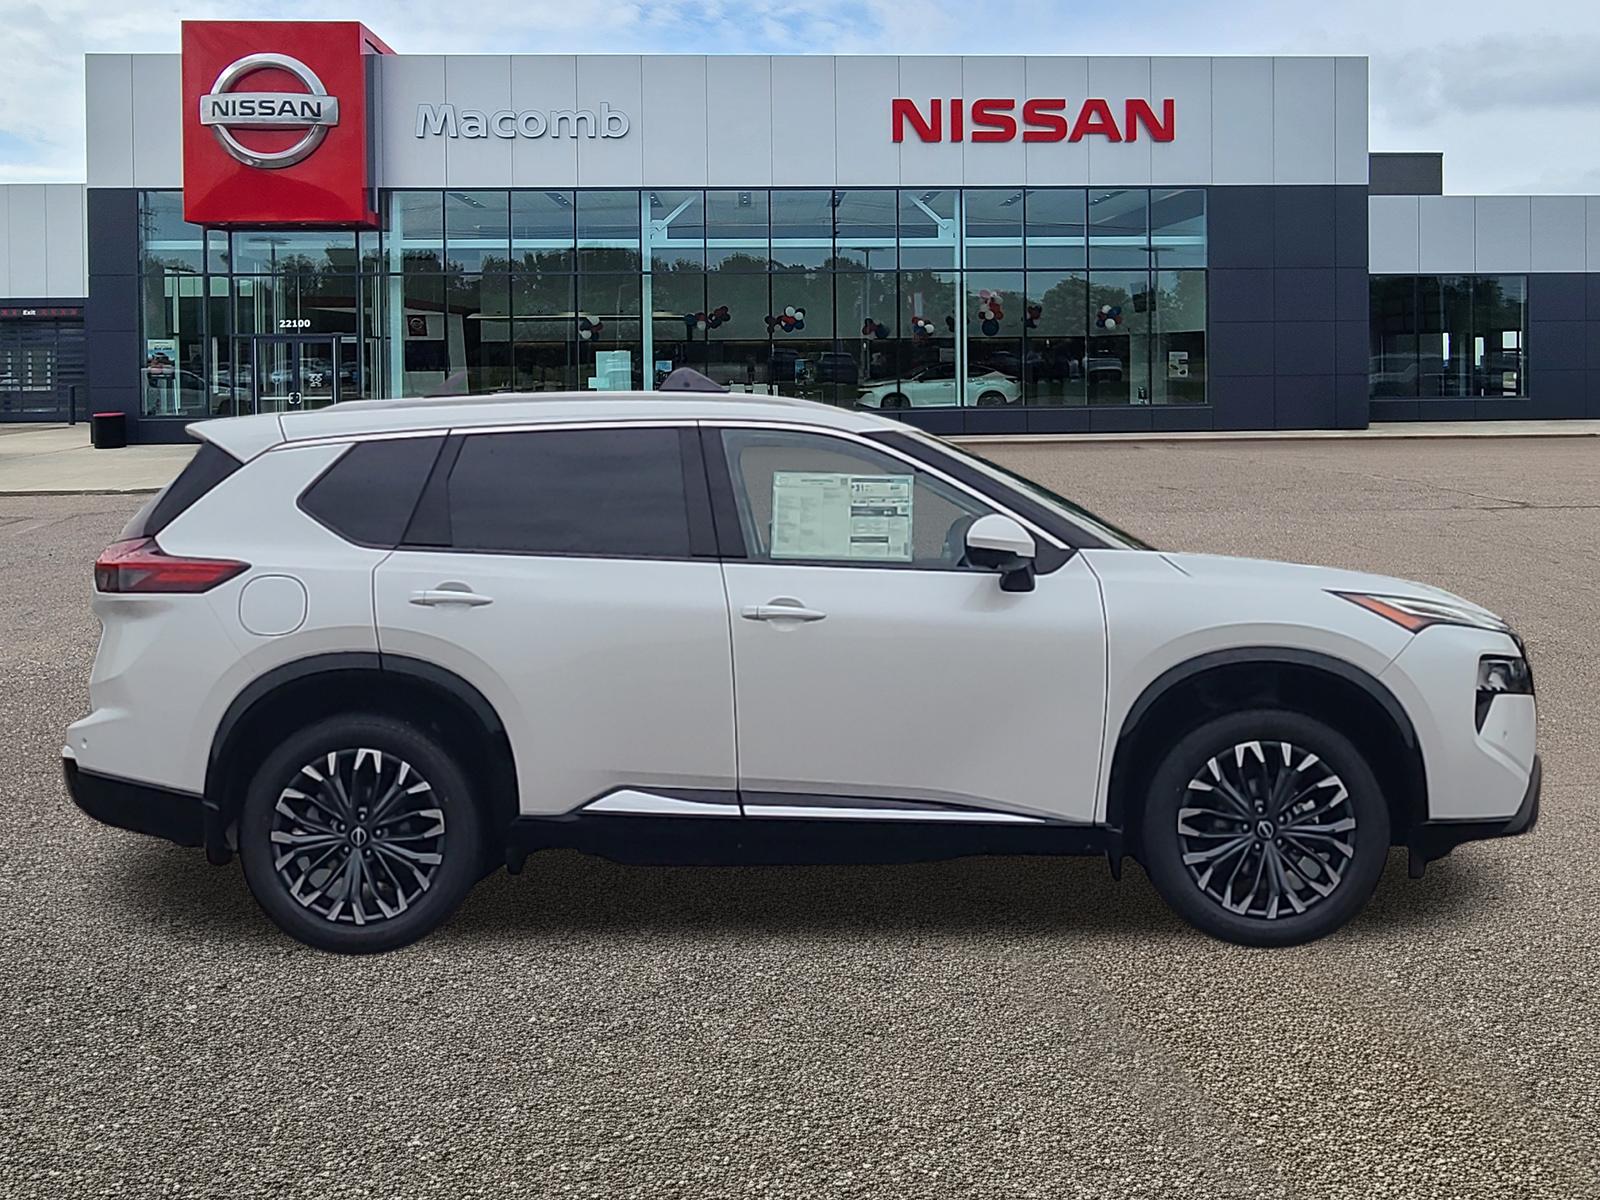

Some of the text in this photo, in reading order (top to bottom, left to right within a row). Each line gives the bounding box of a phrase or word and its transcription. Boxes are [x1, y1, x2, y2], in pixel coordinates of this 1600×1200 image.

[212, 99, 321, 118] NISSAN
[415, 102, 631, 139] Macomb
[891, 98, 1175, 143] NISSAN
[279, 319, 311, 328] 22100
